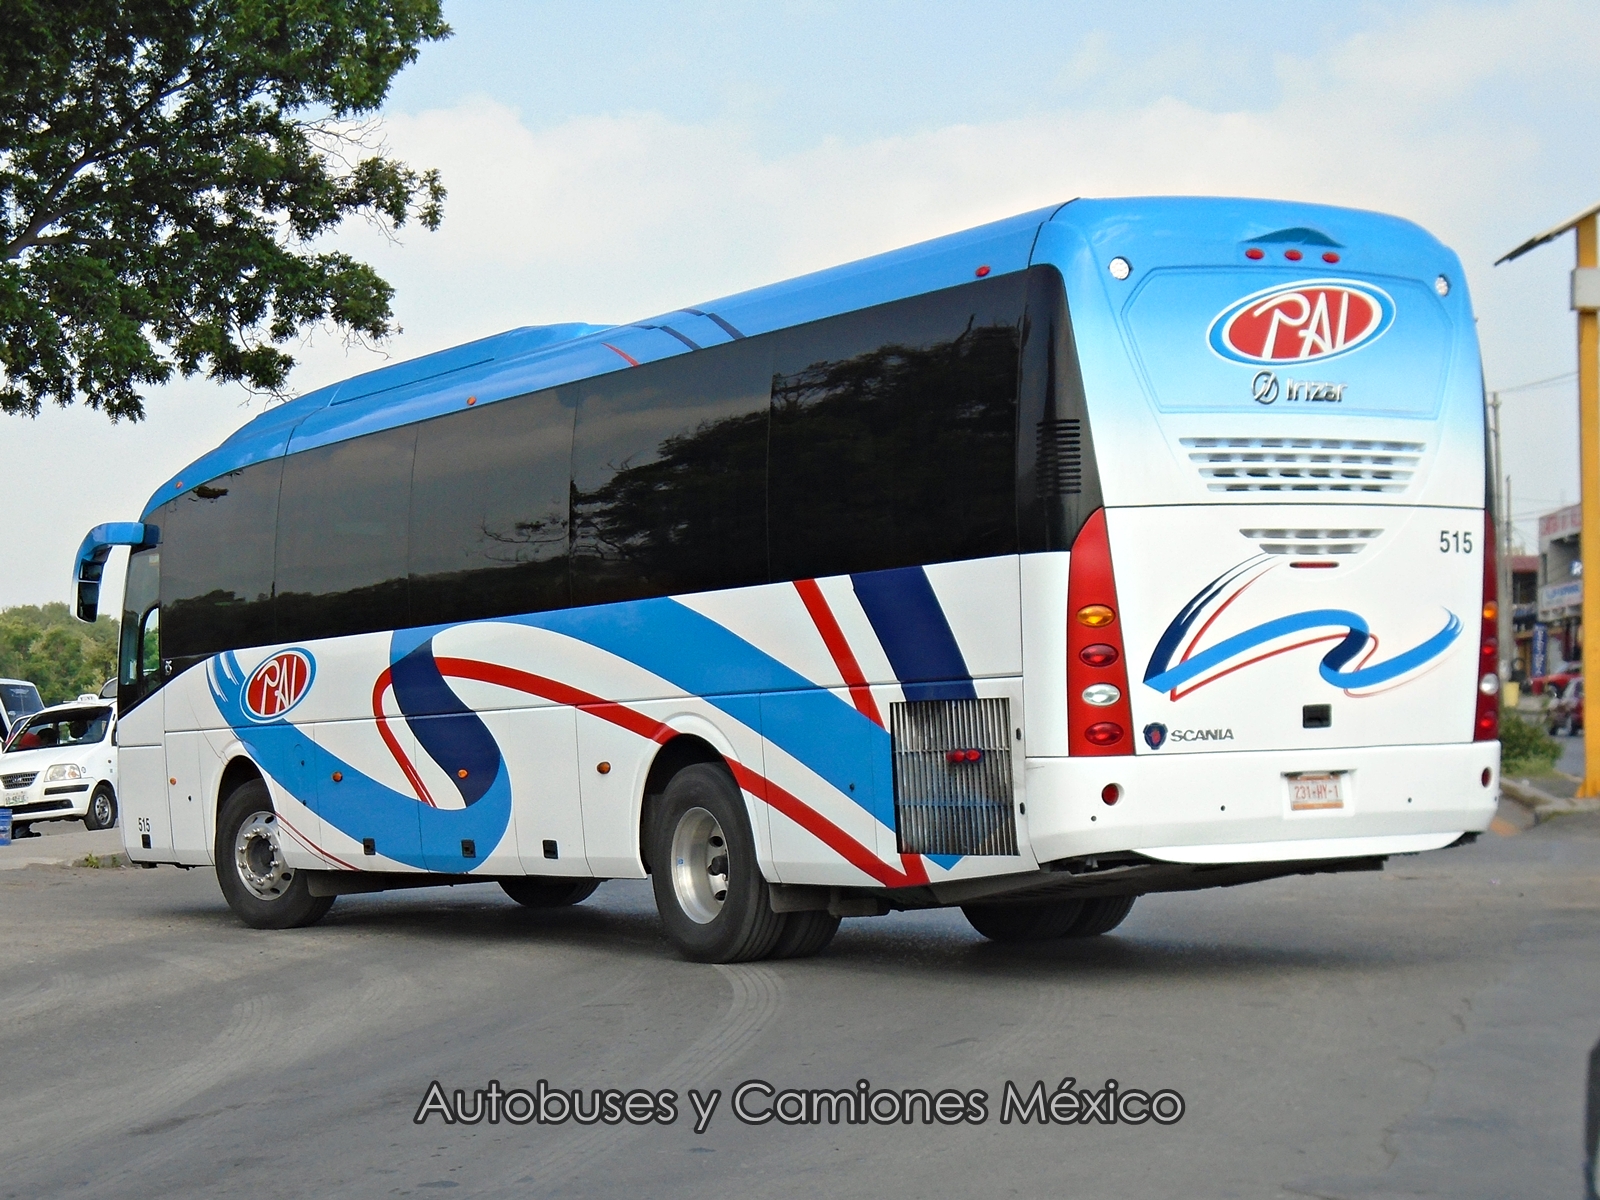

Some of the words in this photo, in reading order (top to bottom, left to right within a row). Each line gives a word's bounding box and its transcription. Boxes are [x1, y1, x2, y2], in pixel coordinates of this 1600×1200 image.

[1286, 378, 1348, 402] Irizar
[1440, 529, 1473, 554] 515
[1170, 728, 1234, 742] SCANIA
[138, 817, 150, 832] 515
